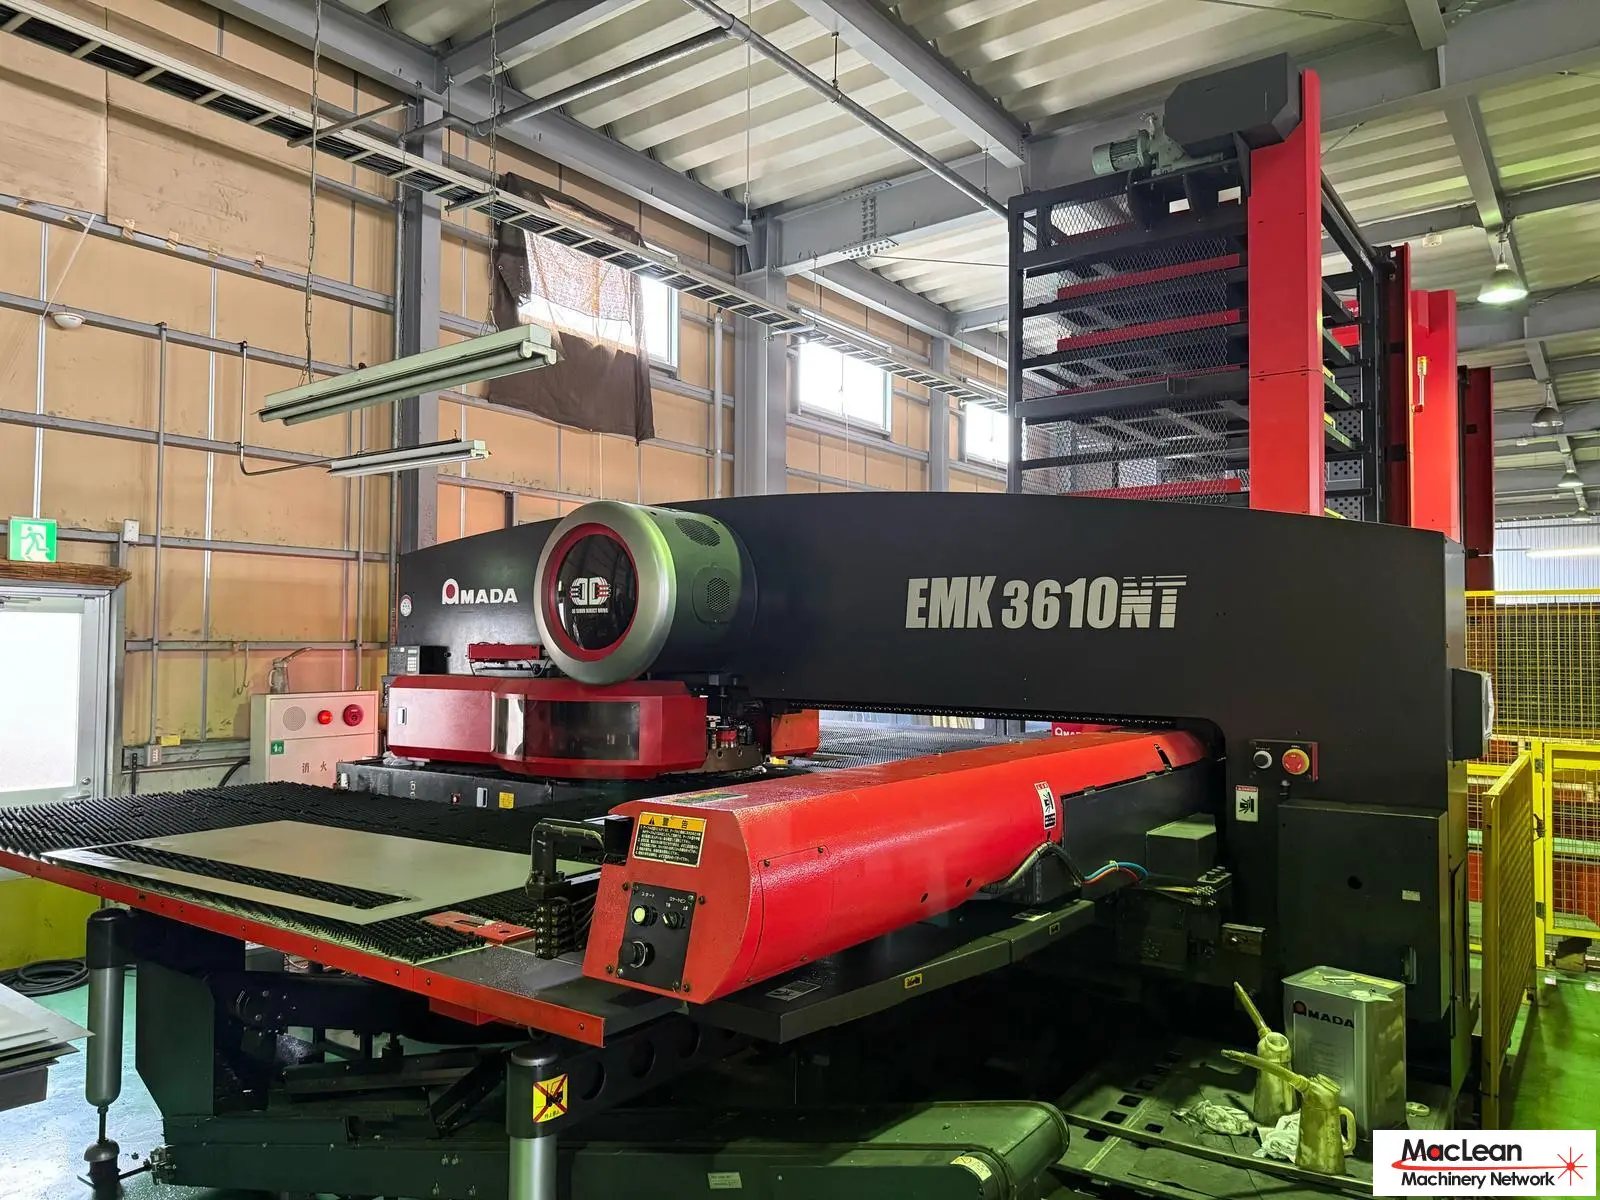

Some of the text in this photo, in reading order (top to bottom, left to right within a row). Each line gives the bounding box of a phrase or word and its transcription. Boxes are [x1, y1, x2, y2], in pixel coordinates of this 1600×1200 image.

[441, 578, 518, 605] AMADA
[905, 575, 997, 629] EMK
[1292, 1000, 1355, 1029] AMADA
